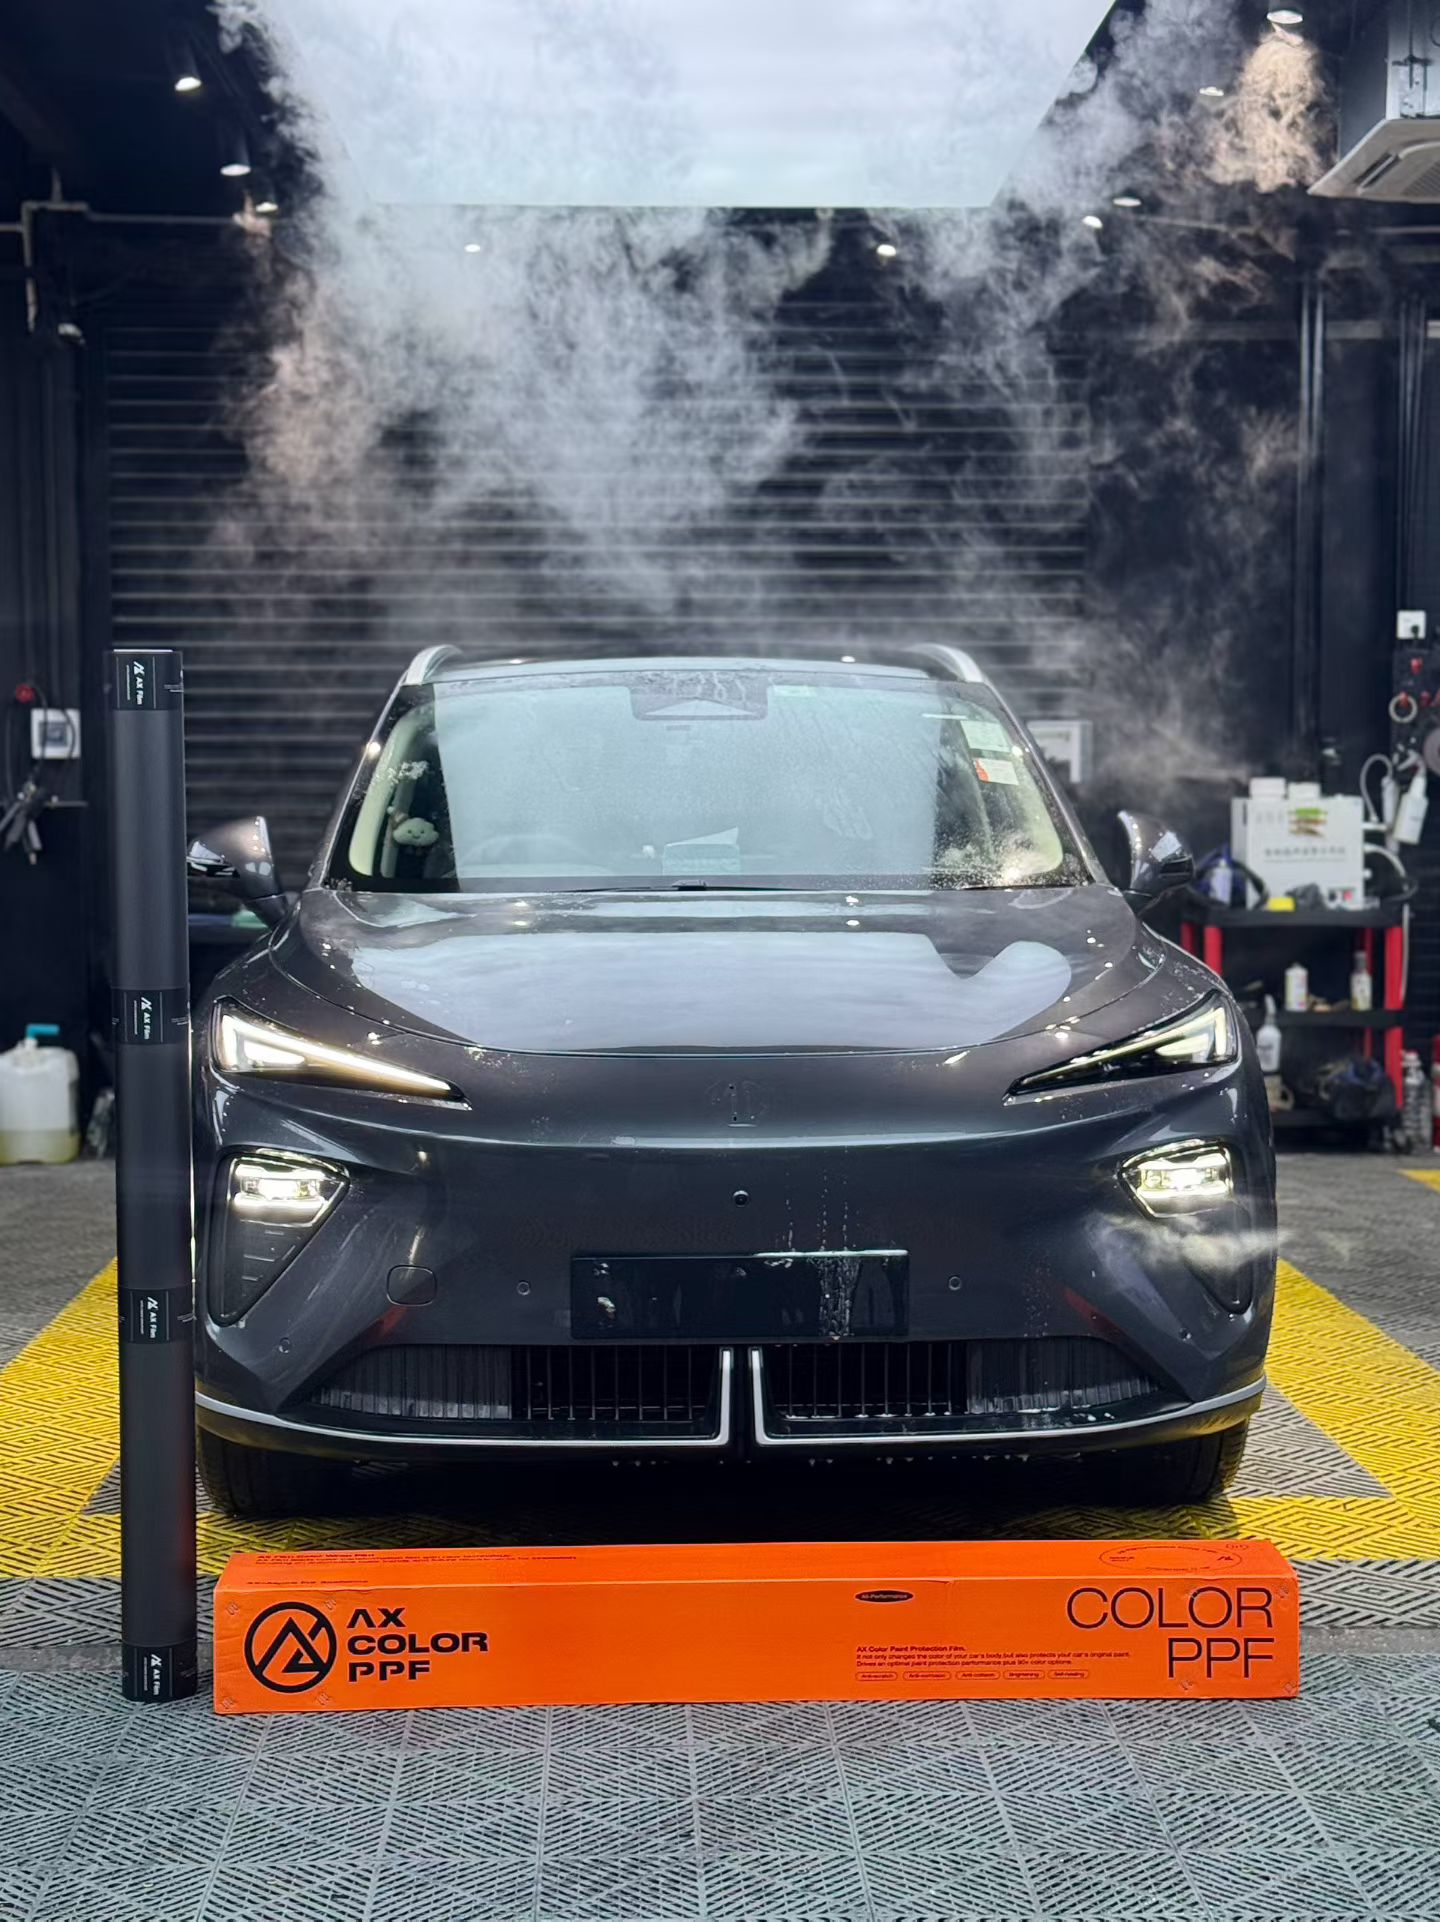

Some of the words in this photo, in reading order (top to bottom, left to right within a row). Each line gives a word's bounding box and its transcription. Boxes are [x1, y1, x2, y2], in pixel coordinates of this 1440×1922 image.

[136, 676, 144, 689] AX
[136, 690, 144, 705] Film
[143, 1012, 151, 1023] AX
[143, 1025, 151, 1040] Film
[149, 1312, 157, 1323] AX
[149, 1324, 157, 1339] Film
[1066, 1586, 1273, 1629] COLOR
[347, 1607, 406, 1629] AX
[347, 1632, 489, 1656] COLOR
[874, 1653, 887, 1661] only
[961, 1659, 1001, 1667] performance
[1168, 1637, 1275, 1678] PPF
[153, 1669, 161, 1679] AX
[348, 1660, 431, 1682] PPF
[153, 1681, 161, 1696] Film
